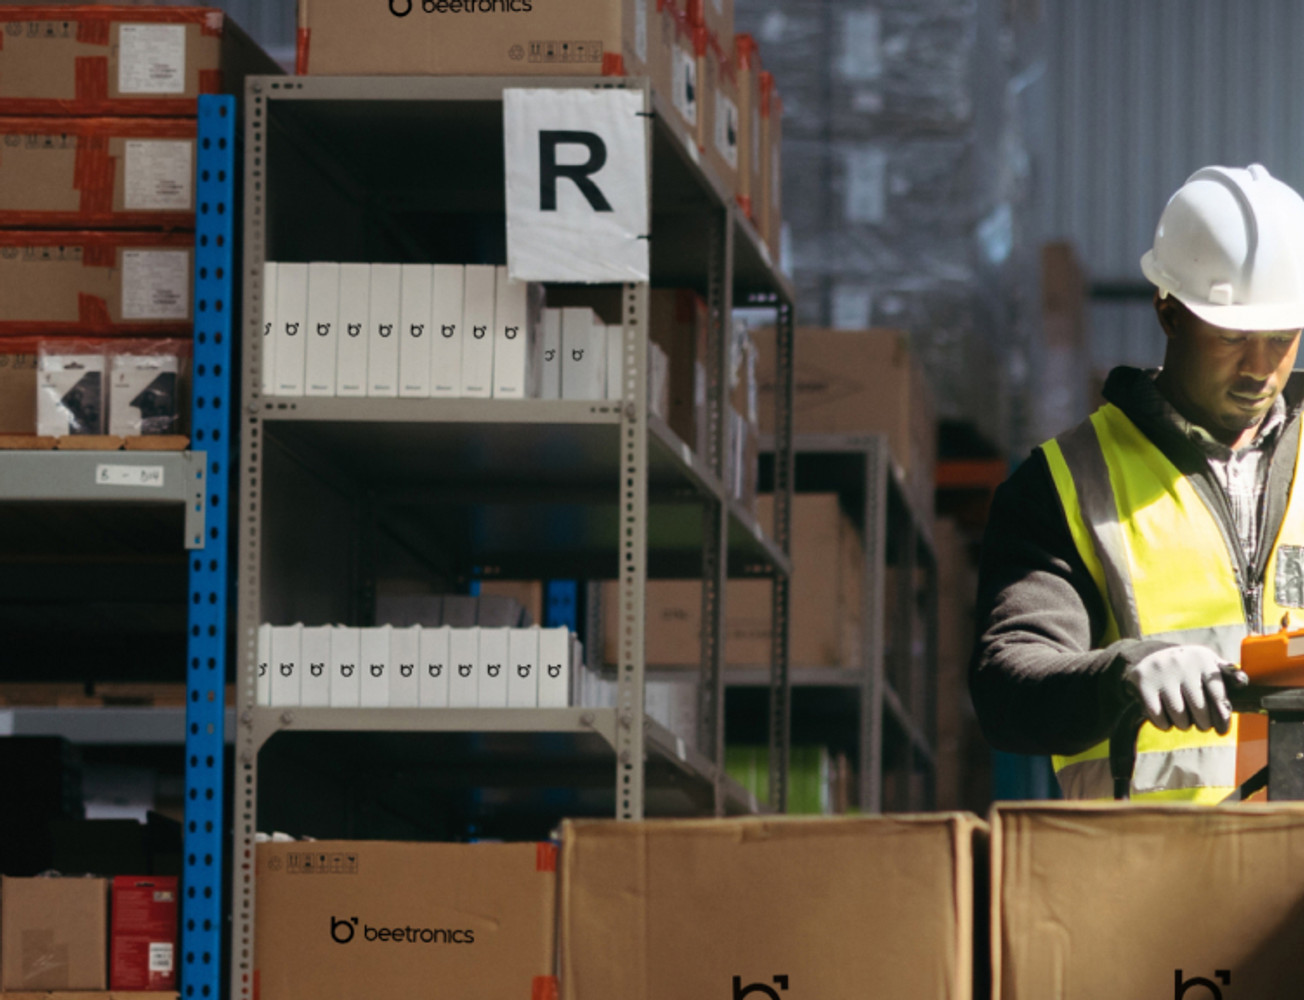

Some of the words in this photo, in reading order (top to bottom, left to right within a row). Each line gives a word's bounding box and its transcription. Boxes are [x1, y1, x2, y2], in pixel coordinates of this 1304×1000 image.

[422, 0, 533, 13] beetronics
[538, 129, 613, 213] R
[364, 924, 475, 944] beetronics
